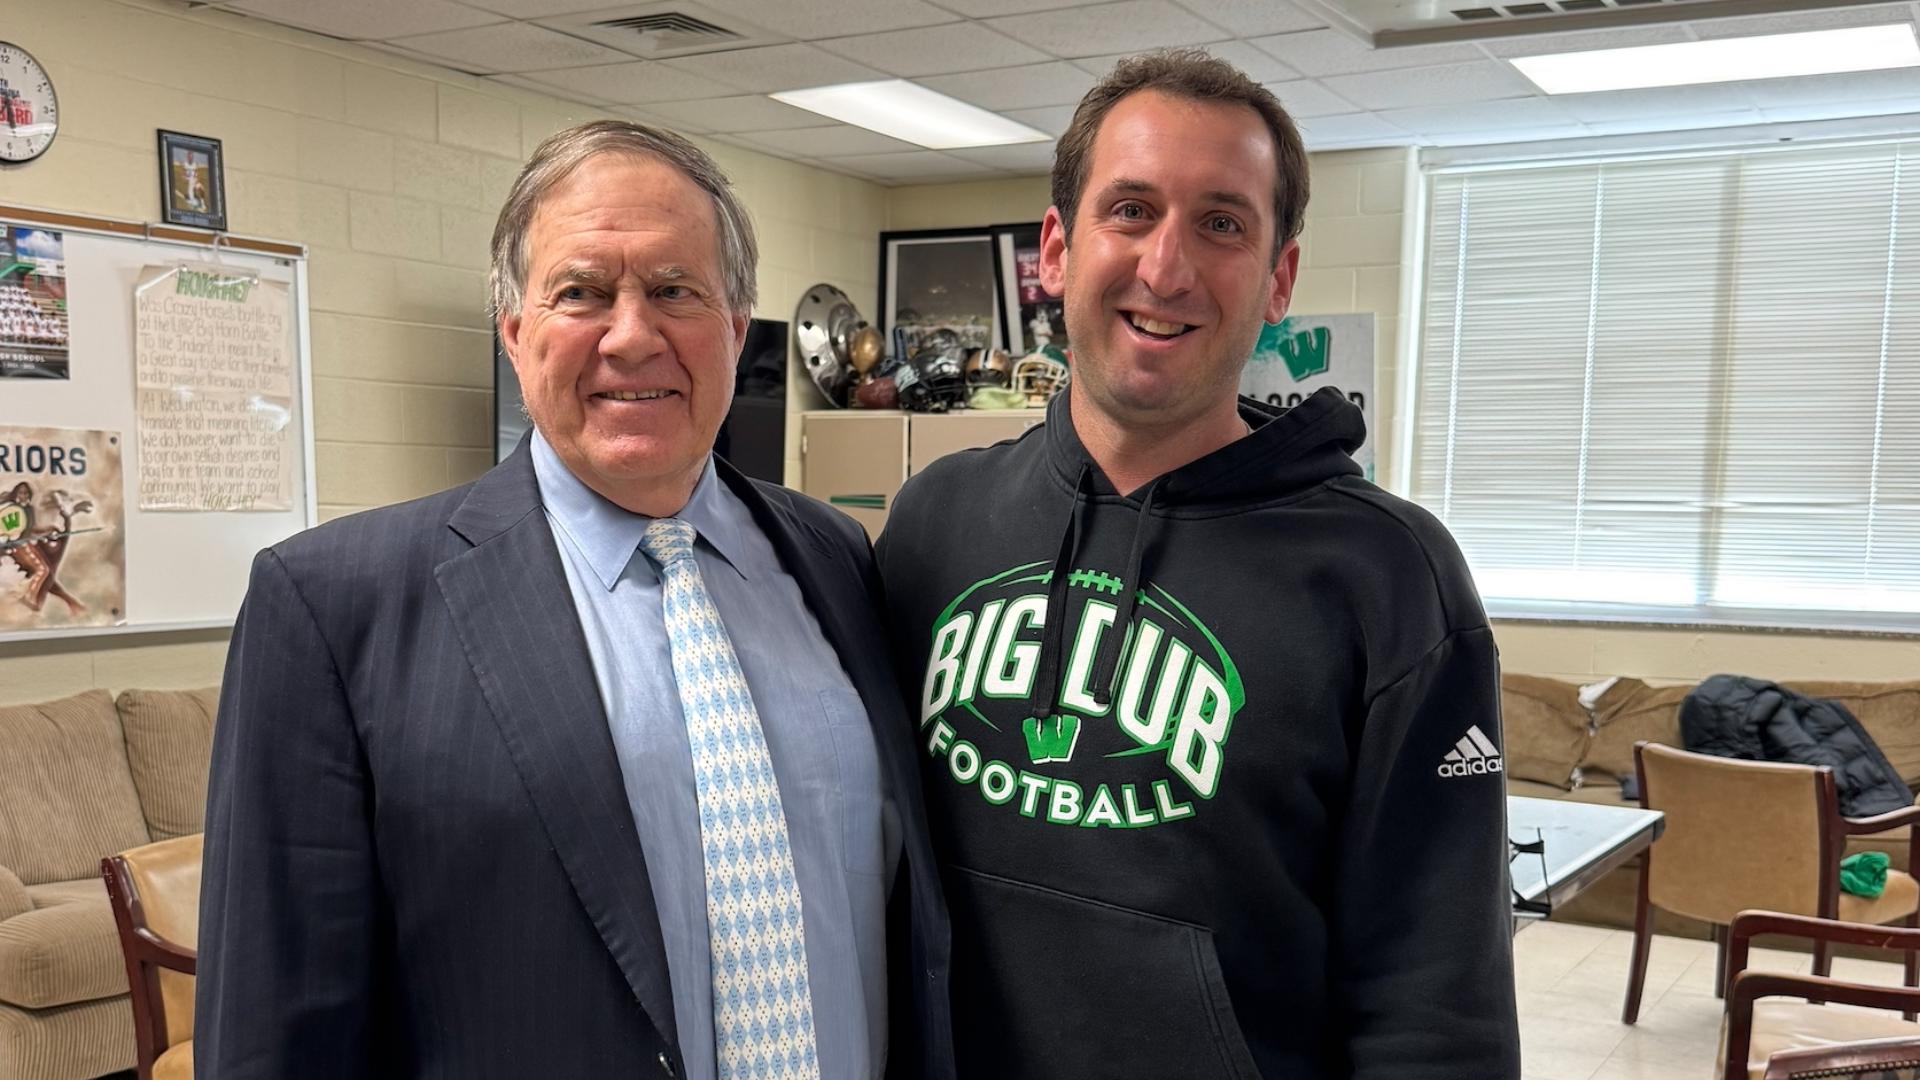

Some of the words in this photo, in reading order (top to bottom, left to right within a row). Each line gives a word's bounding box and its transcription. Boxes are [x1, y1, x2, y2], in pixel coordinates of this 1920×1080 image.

[12, 353, 46, 363] SCHOOL
[0, 444, 87, 476] RIORS
[2, 511, 20, 531] W
[921, 594, 1050, 730] BIG
[1022, 713, 1081, 765] W
[928, 715, 1197, 829] FOOTBALL
